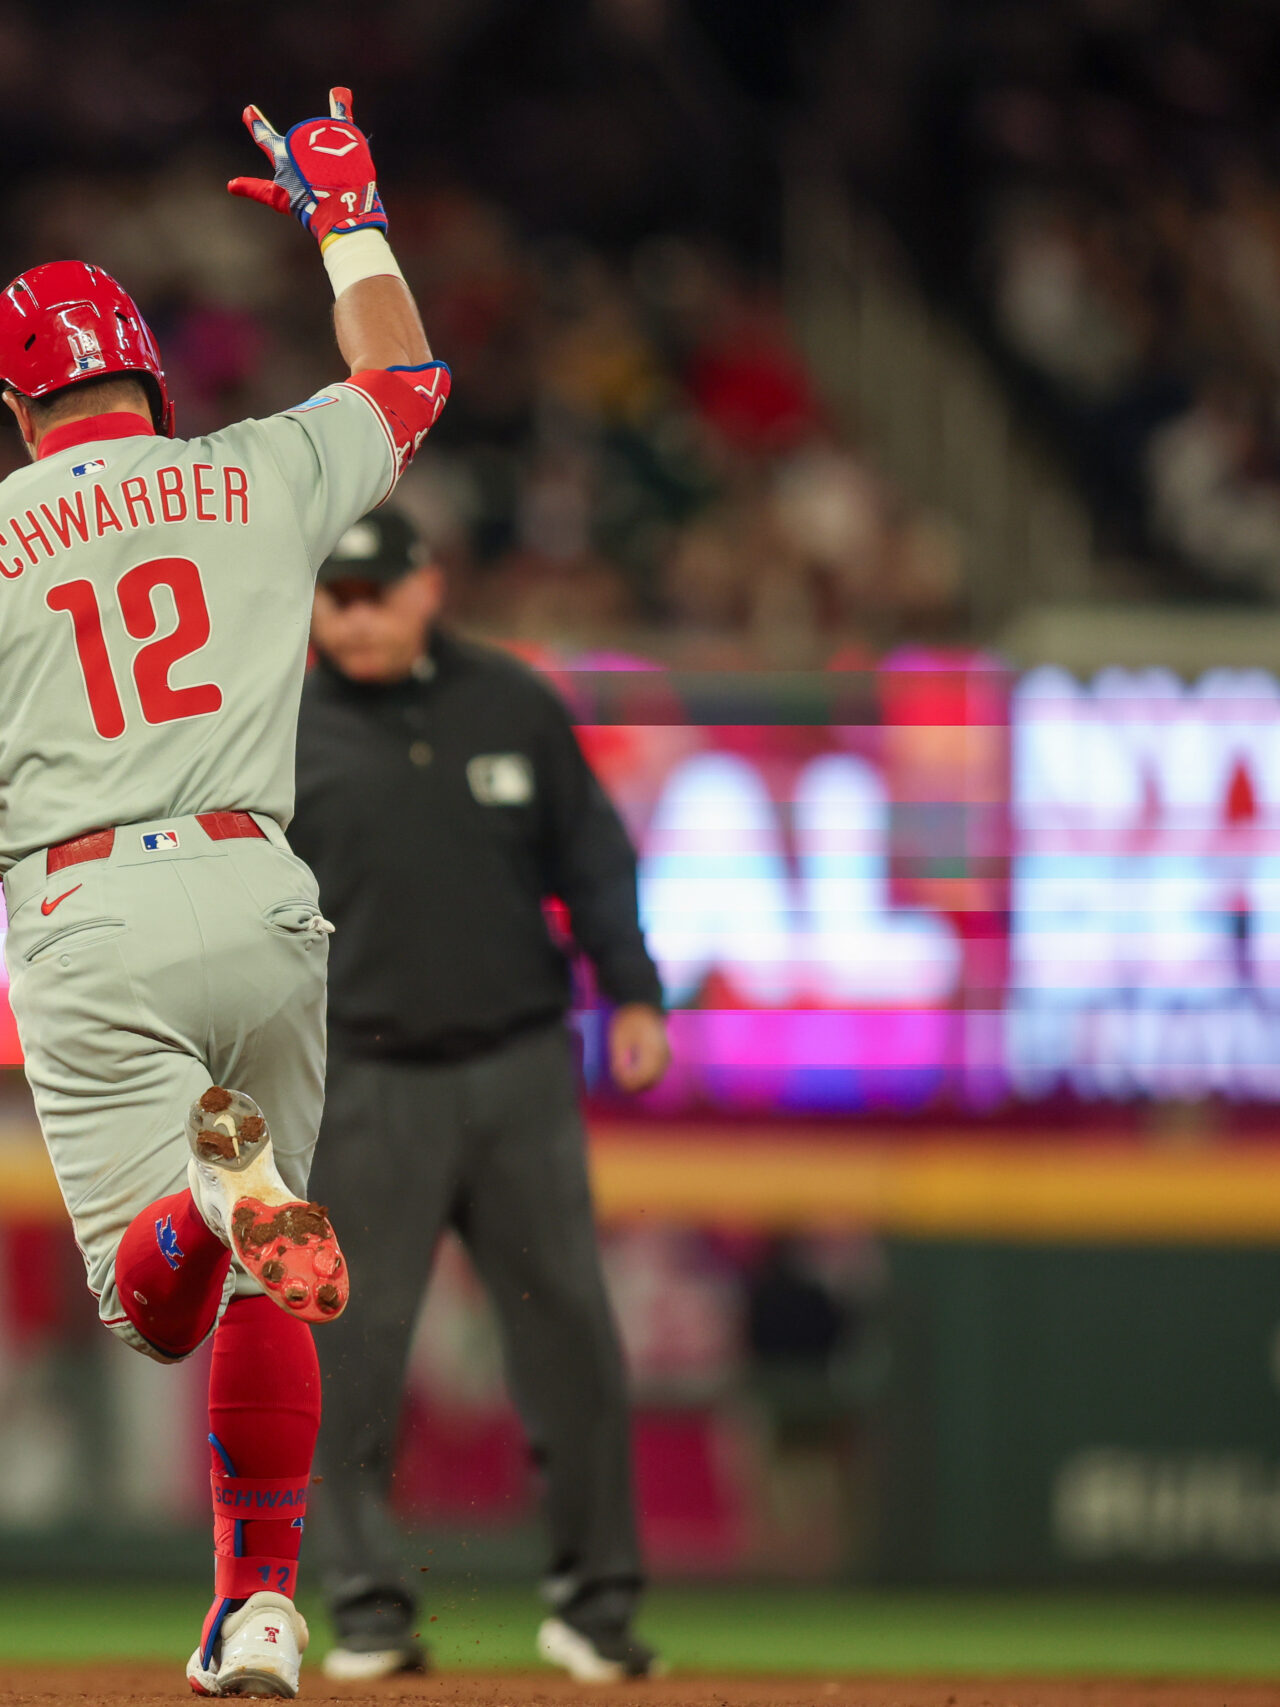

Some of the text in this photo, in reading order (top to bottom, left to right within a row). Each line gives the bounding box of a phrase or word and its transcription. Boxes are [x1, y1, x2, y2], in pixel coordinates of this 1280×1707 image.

[340, 191, 357, 213] P
[46, 555, 223, 741] 12
[215, 1485, 307, 1508] SCHWAR
[257, 1565, 290, 1592] 12
